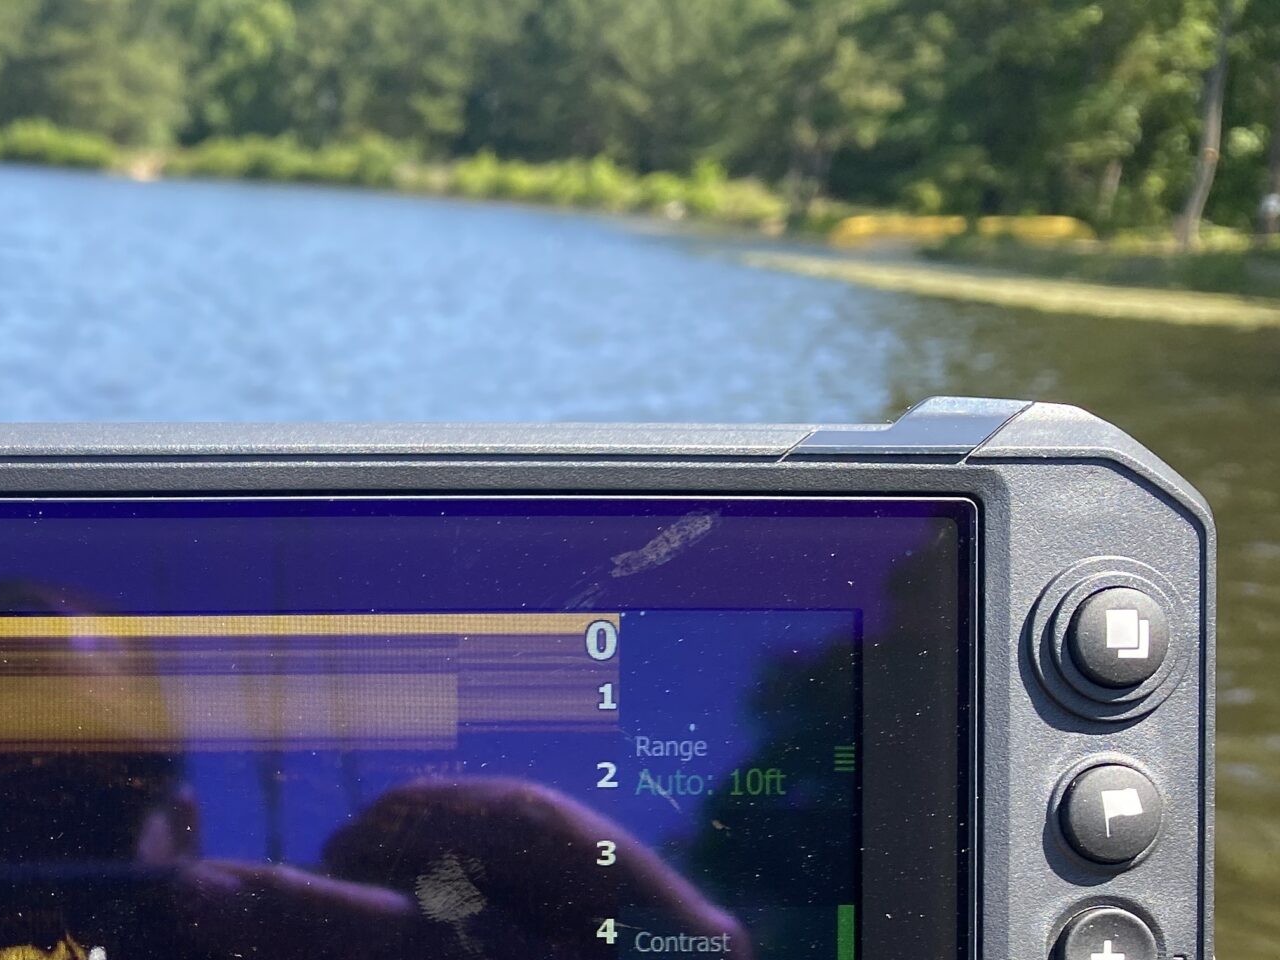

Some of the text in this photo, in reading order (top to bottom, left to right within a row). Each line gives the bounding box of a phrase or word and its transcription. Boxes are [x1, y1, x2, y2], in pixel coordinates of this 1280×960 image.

[585, 620, 617, 660] 0
[598, 683, 617, 710] 1
[635, 736, 707, 761] Range
[596, 762, 618, 788] 2
[635, 769, 787, 796] Auto: 10ft
[596, 840, 617, 866] 3
[596, 918, 618, 945] 4
[634, 932, 731, 953] Contrast
